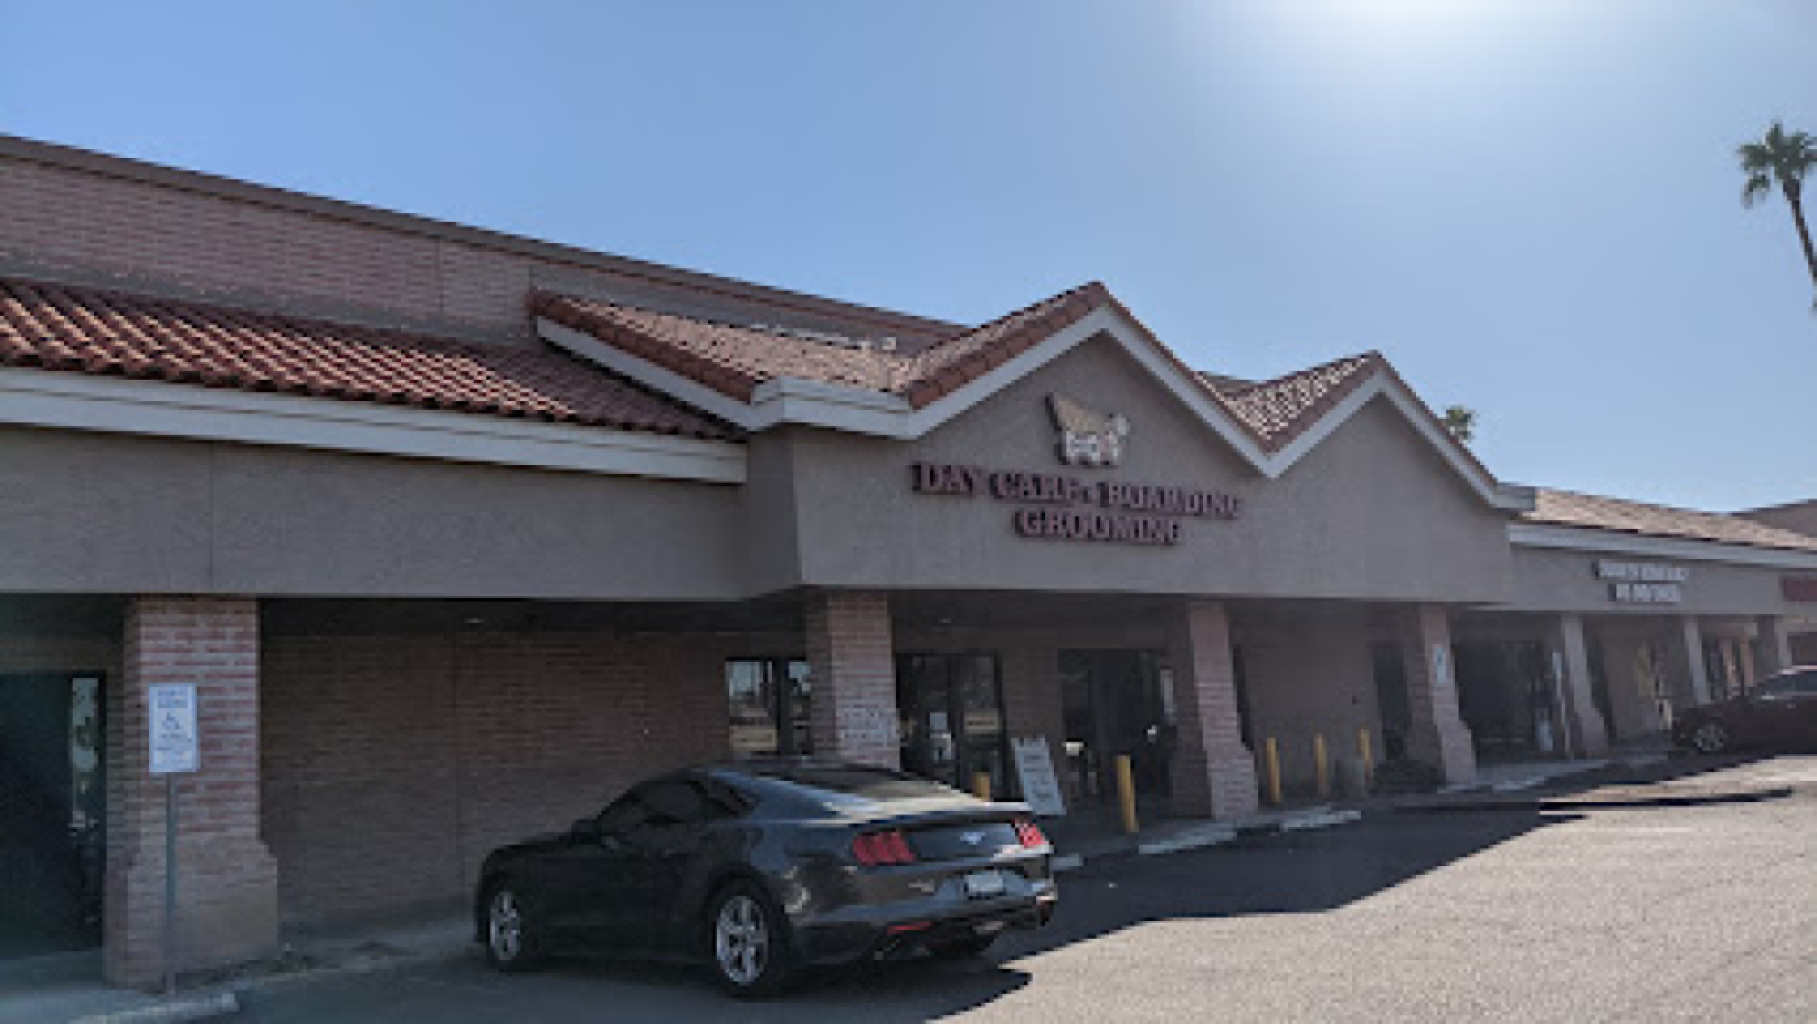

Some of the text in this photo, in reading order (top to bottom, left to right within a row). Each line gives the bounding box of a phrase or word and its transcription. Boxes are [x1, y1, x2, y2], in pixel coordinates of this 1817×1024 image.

[914, 463, 984, 495] DAY
[990, 472, 1081, 504] CARE
[1102, 483, 1239, 520] BOARDING
[1015, 509, 1182, 546] GROOMING
